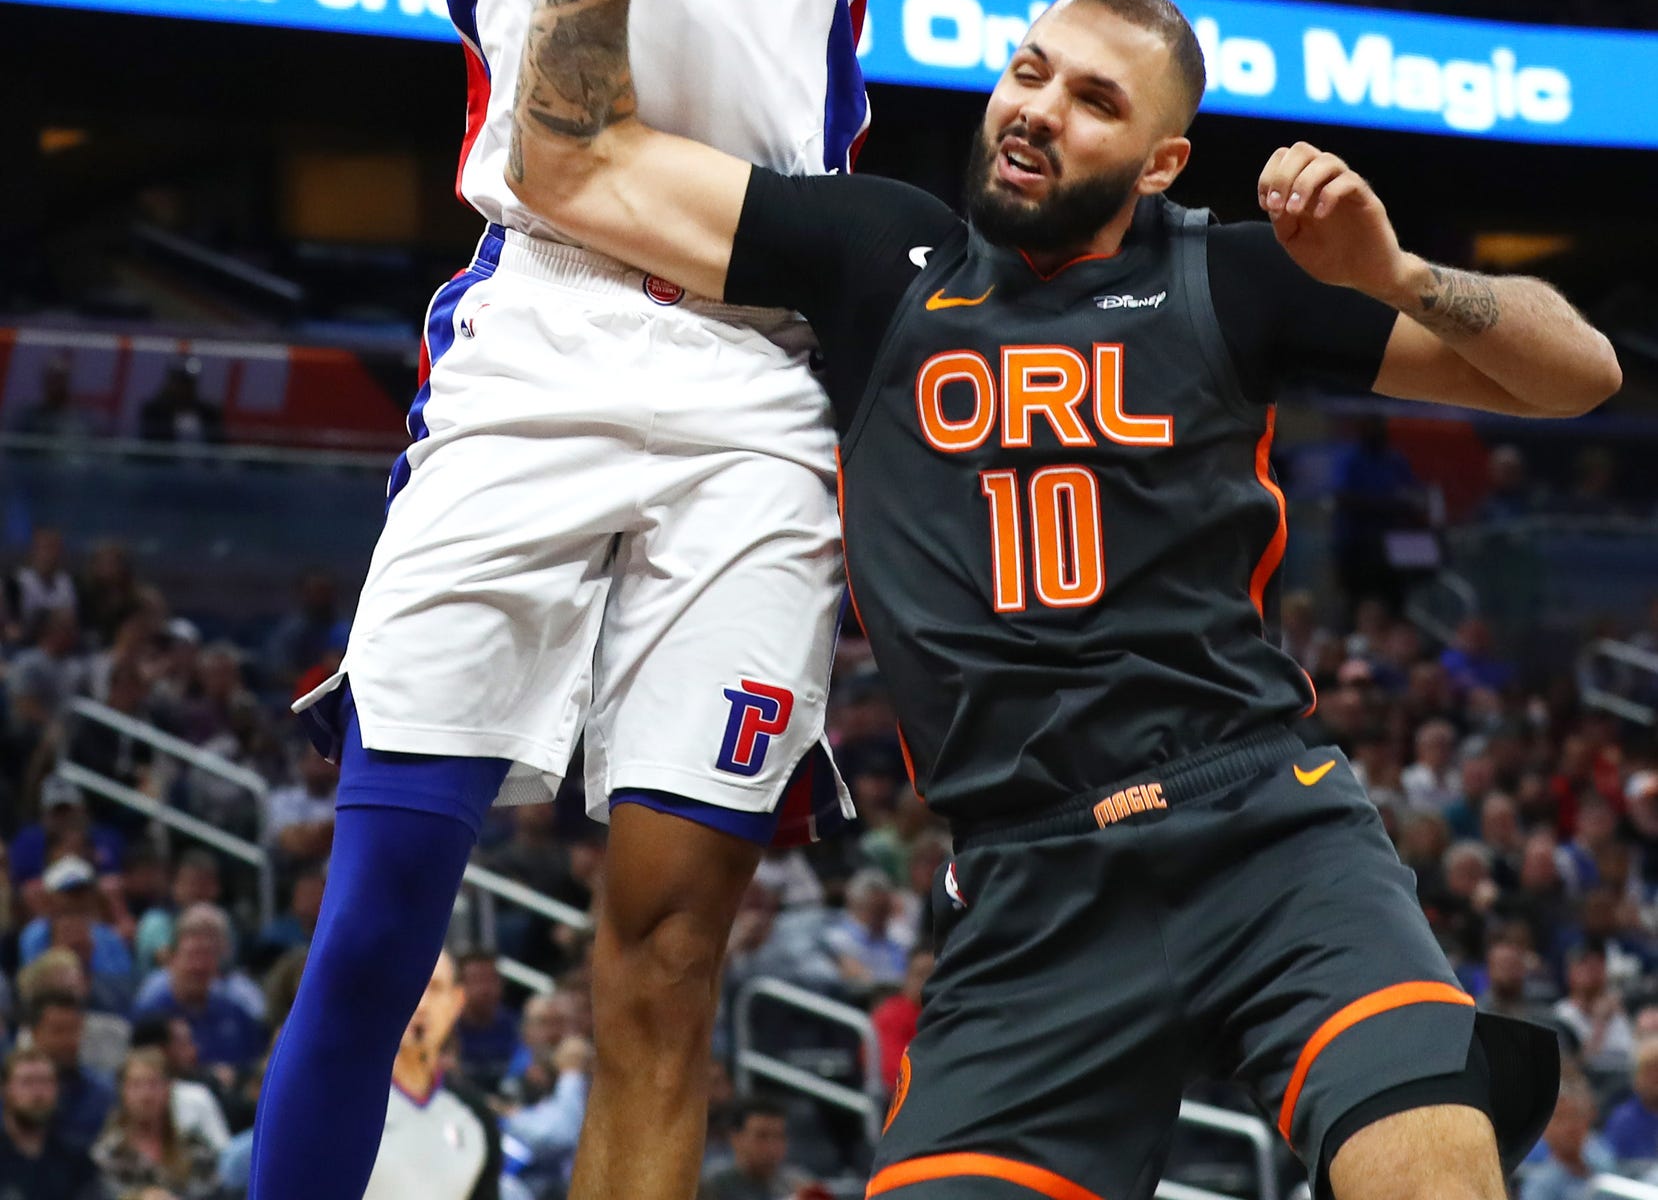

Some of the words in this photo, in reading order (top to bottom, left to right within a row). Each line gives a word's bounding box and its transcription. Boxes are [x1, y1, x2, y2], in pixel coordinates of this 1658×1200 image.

[1303, 29, 1572, 131] Magic
[915, 342, 1174, 453] ORL
[979, 463, 1106, 613] 10
[1092, 782, 1168, 831] MAGIC
